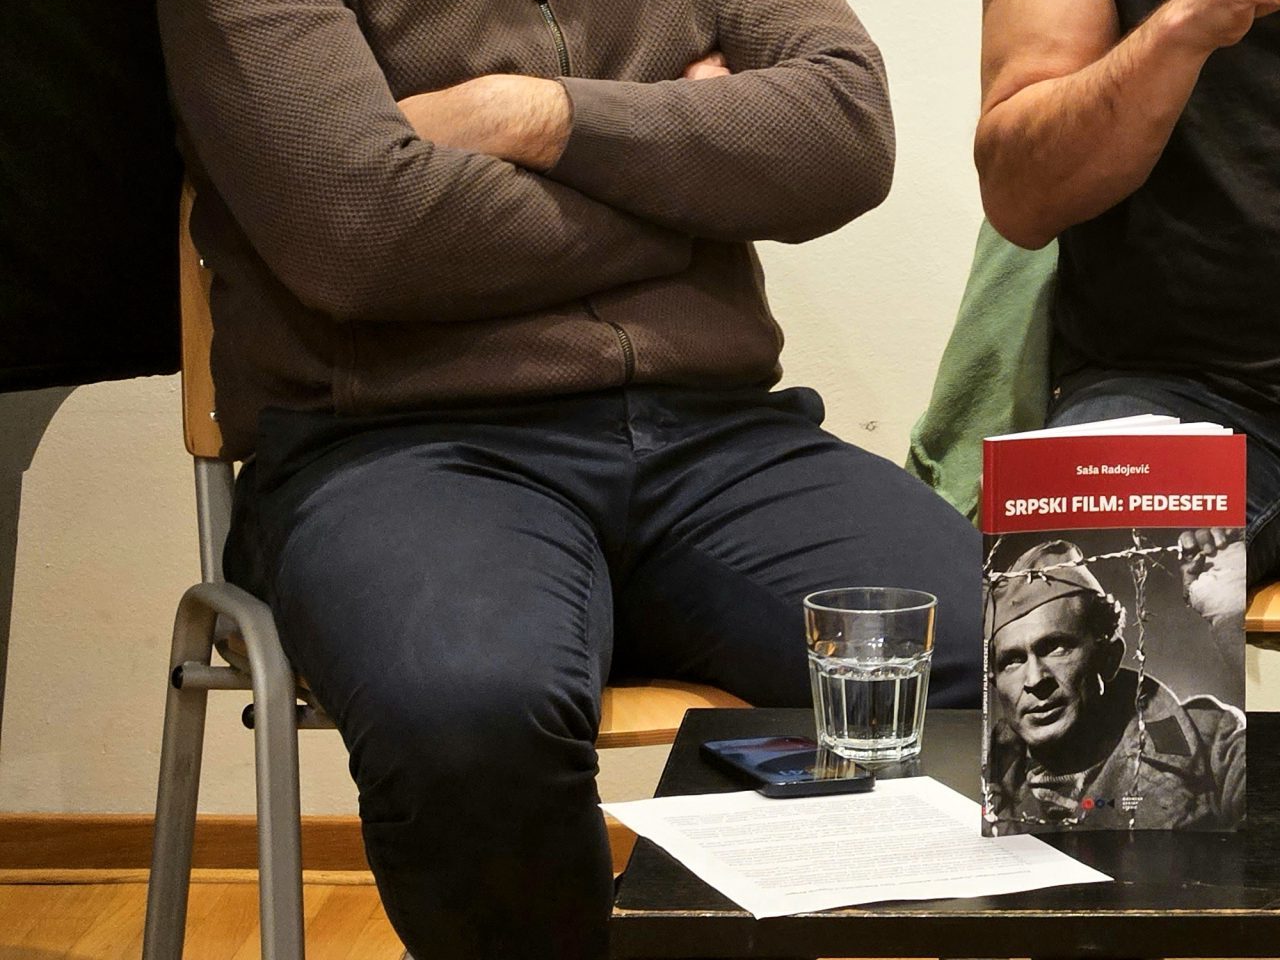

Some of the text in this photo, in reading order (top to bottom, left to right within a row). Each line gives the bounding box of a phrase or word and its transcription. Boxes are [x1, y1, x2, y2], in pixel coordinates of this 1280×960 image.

[1076, 463, 1150, 477] Saša Radojević
[1005, 494, 1228, 516] SRPSKI FILM: PEDESETE
